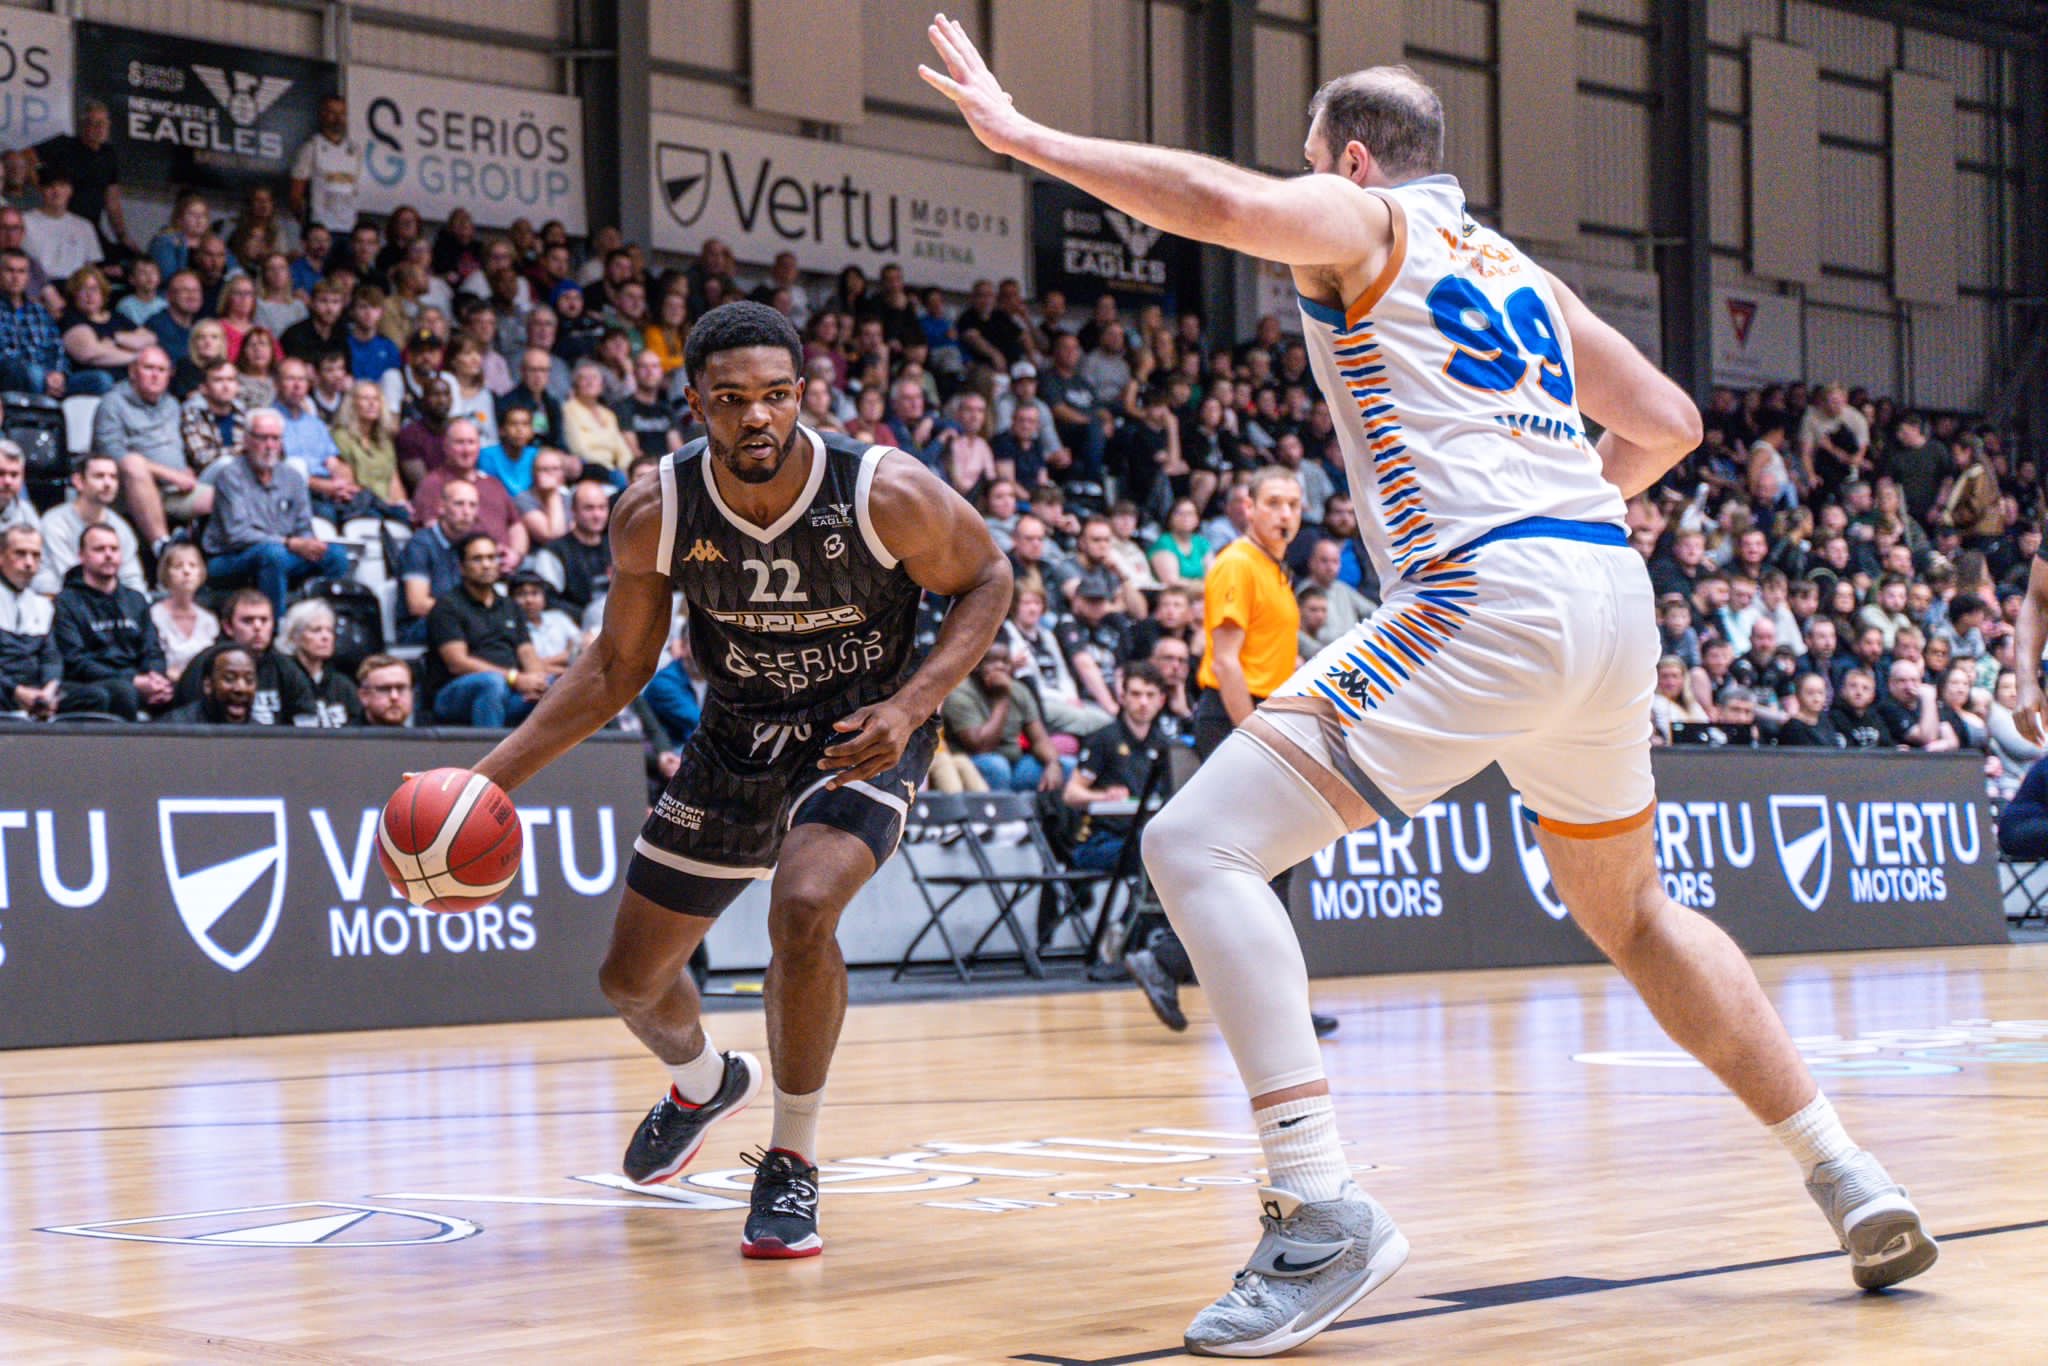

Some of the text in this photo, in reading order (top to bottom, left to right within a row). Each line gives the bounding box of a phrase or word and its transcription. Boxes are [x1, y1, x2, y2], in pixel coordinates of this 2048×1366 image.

[128, 111, 284, 159] EAGLES
[416, 107, 570, 164] SERIÖS
[418, 154, 571, 206] GROUP
[721, 151, 1009, 253] Vertu Motors
[1425, 274, 1574, 408] 99
[1494, 414, 1586, 442] WHIT
[742, 559, 808, 602] 22
[655, 805, 701, 830] LEAGUE
[1655, 801, 1756, 869] RTU
[1836, 801, 1981, 867] VERTU
[309, 807, 617, 901] VTU
[1310, 876, 1443, 920] MOTORS
[1849, 866, 1947, 903] MOTORS
[329, 904, 537, 957] MOTORS
